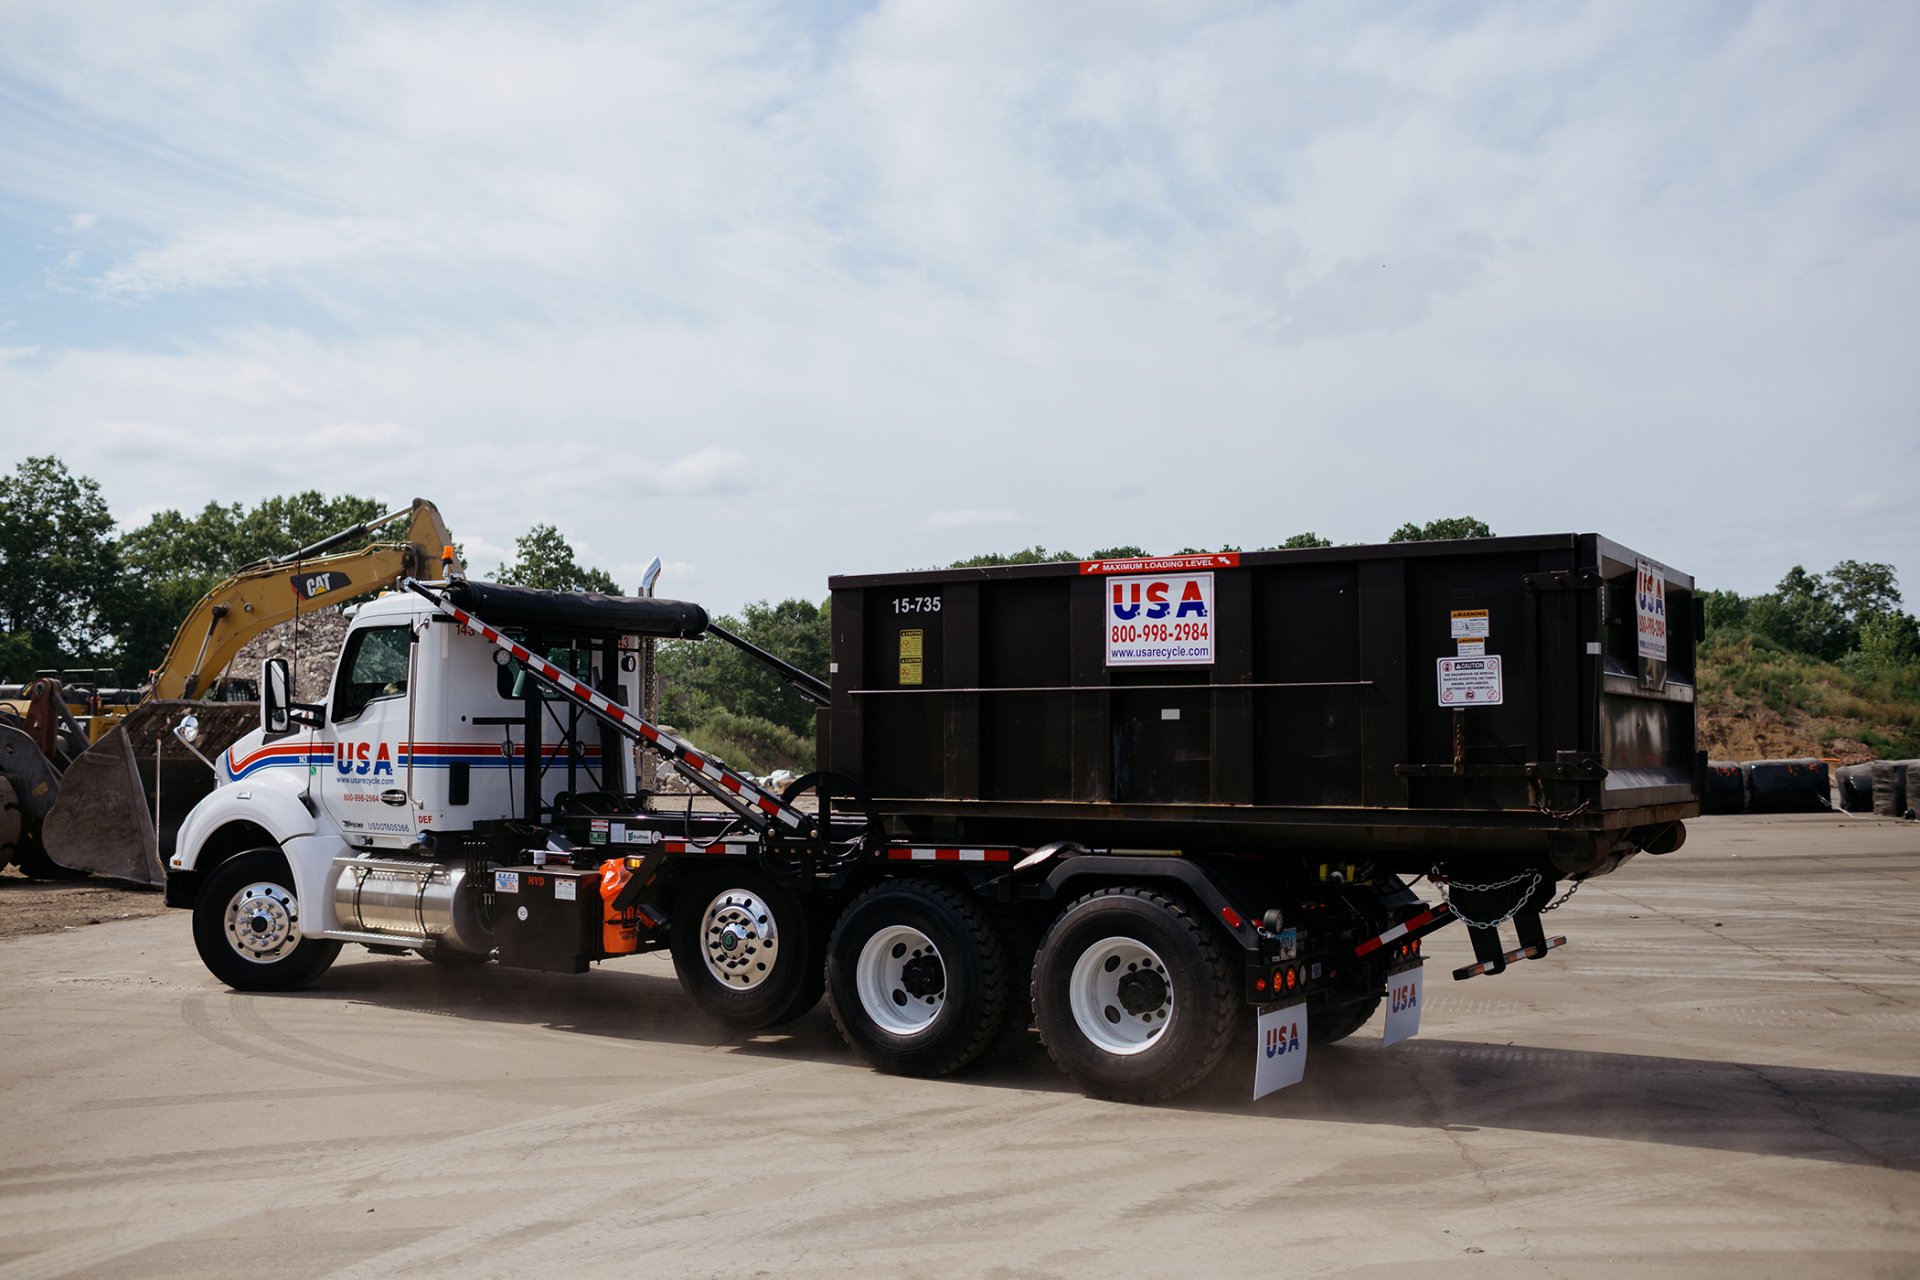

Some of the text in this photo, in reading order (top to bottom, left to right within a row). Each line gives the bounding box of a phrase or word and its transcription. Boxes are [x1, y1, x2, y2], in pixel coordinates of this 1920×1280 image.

[1102, 559, 1214, 571] MAXIMUM LOADING LEVEL
[306, 572, 331, 597] CAT
[1639, 571, 1664, 616] USA
[892, 596, 941, 614] 15-735
[1112, 580, 1208, 621] USA
[456, 624, 475, 637] 143
[1111, 622, 1209, 644] 800-998-2984
[1111, 646, 1209, 660] www.usarecycle.com
[337, 742, 393, 775] USA
[336, 776, 394, 786] www.usarecycle.com
[418, 815, 433, 824] DEF
[527, 875, 545, 887] HYD
[1391, 983, 1417, 1014] USA
[1266, 1022, 1300, 1059] USA
